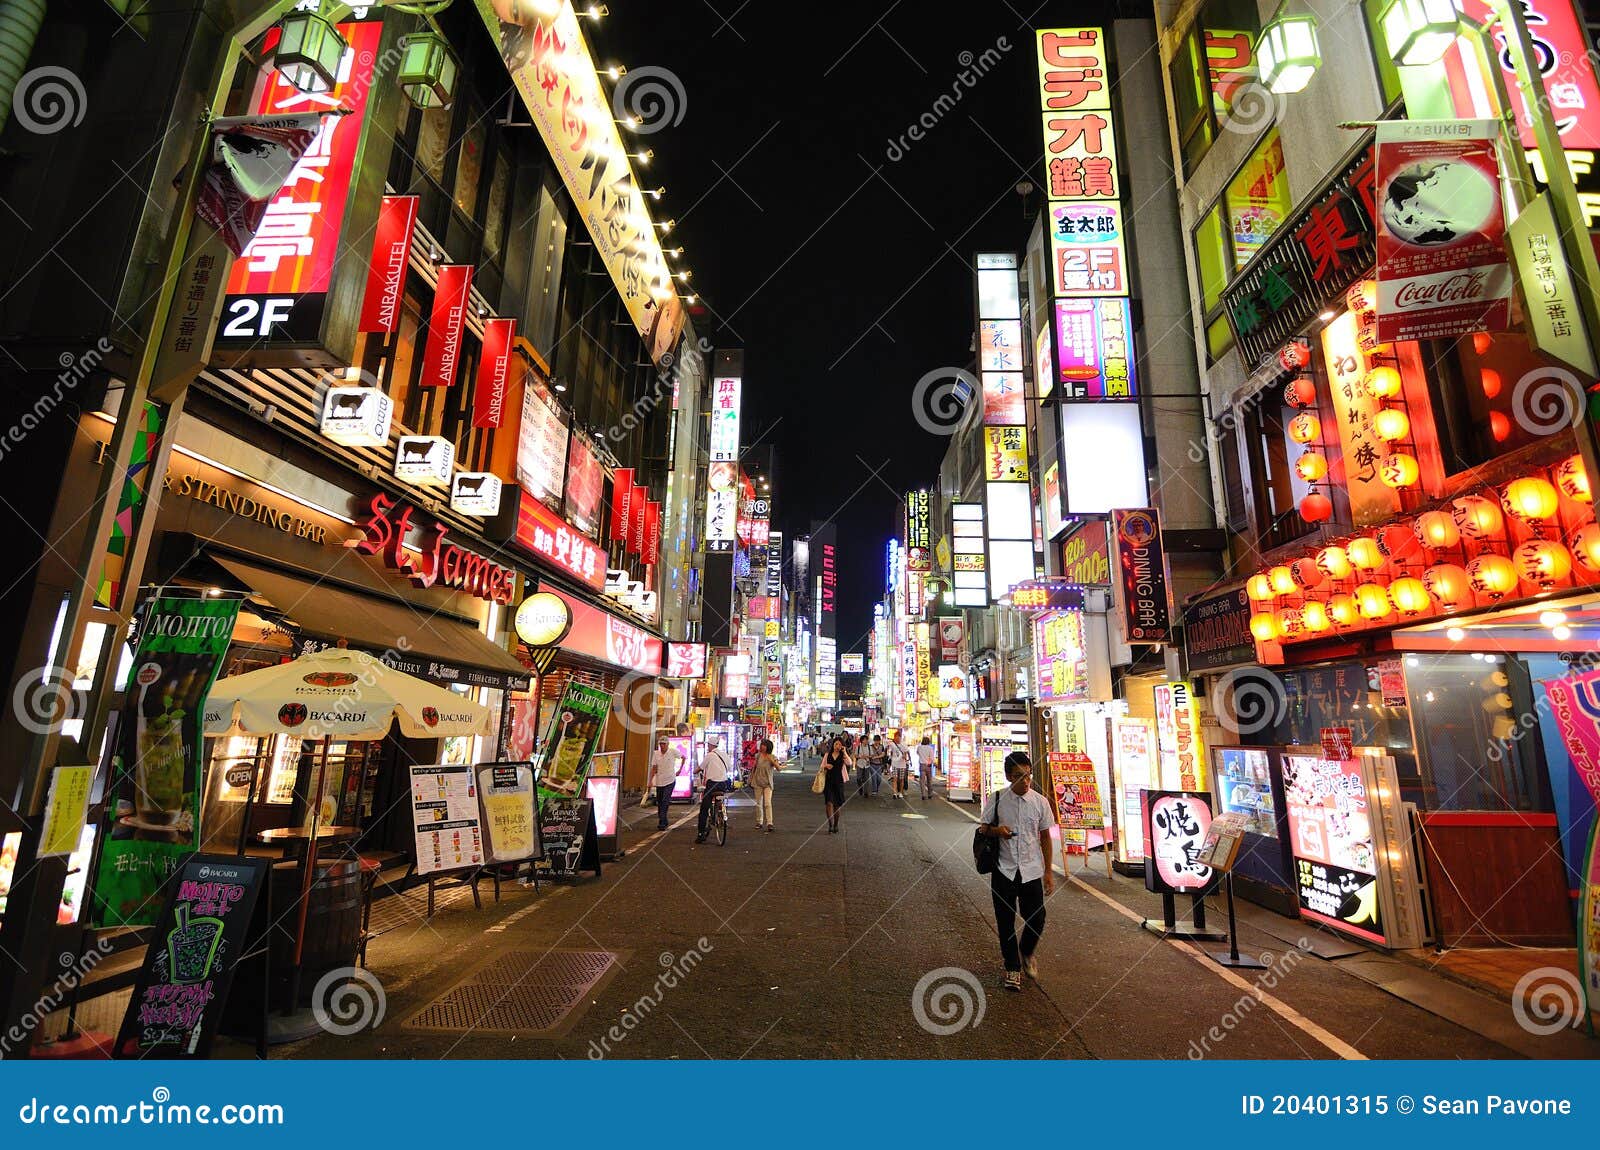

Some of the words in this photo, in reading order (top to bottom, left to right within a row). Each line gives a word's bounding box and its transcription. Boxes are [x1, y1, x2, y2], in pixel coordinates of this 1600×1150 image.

[1041, 31, 1107, 154] ビデオ
[1050, 157, 1115, 197] 鑑賞
[1058, 215, 1115, 235] 金太郎
[1063, 249, 1113, 272] 2F
[377, 241, 406, 329] ANRAKUTEI
[1063, 270, 1117, 292] 受付
[223, 298, 294, 337] 2F
[439, 305, 463, 385] ANRAKUTEI
[488, 354, 507, 424] ANRAKUTEI
[718, 380, 736, 409] 麻雀
[1063, 382, 1086, 398] 1F
[1003, 428, 1021, 450] 麻雀
[178, 473, 292, 533] STANDING
[297, 517, 327, 545] BAR
[619, 492, 631, 537] ANRAKUTEI
[635, 508, 644, 550] ANRAKUTEI
[649, 522, 658, 562] ANRAKUTEI
[409, 521, 515, 606] James
[555, 526, 598, 580] 安楽亭
[1132, 547, 1154, 597] DINING
[150, 613, 235, 640] MOJITO!
[1138, 600, 1157, 627] BAR
[1198, 603, 1218, 618] DINING
[1218, 599, 1231, 611] BAR
[309, 710, 367, 723] BACARDÍ
[566, 689, 610, 712] MOJITO!
[229, 769, 252, 784] OPEN
[1155, 801, 1210, 877] 焼鳥
[177, 880, 245, 903] MOJITO
